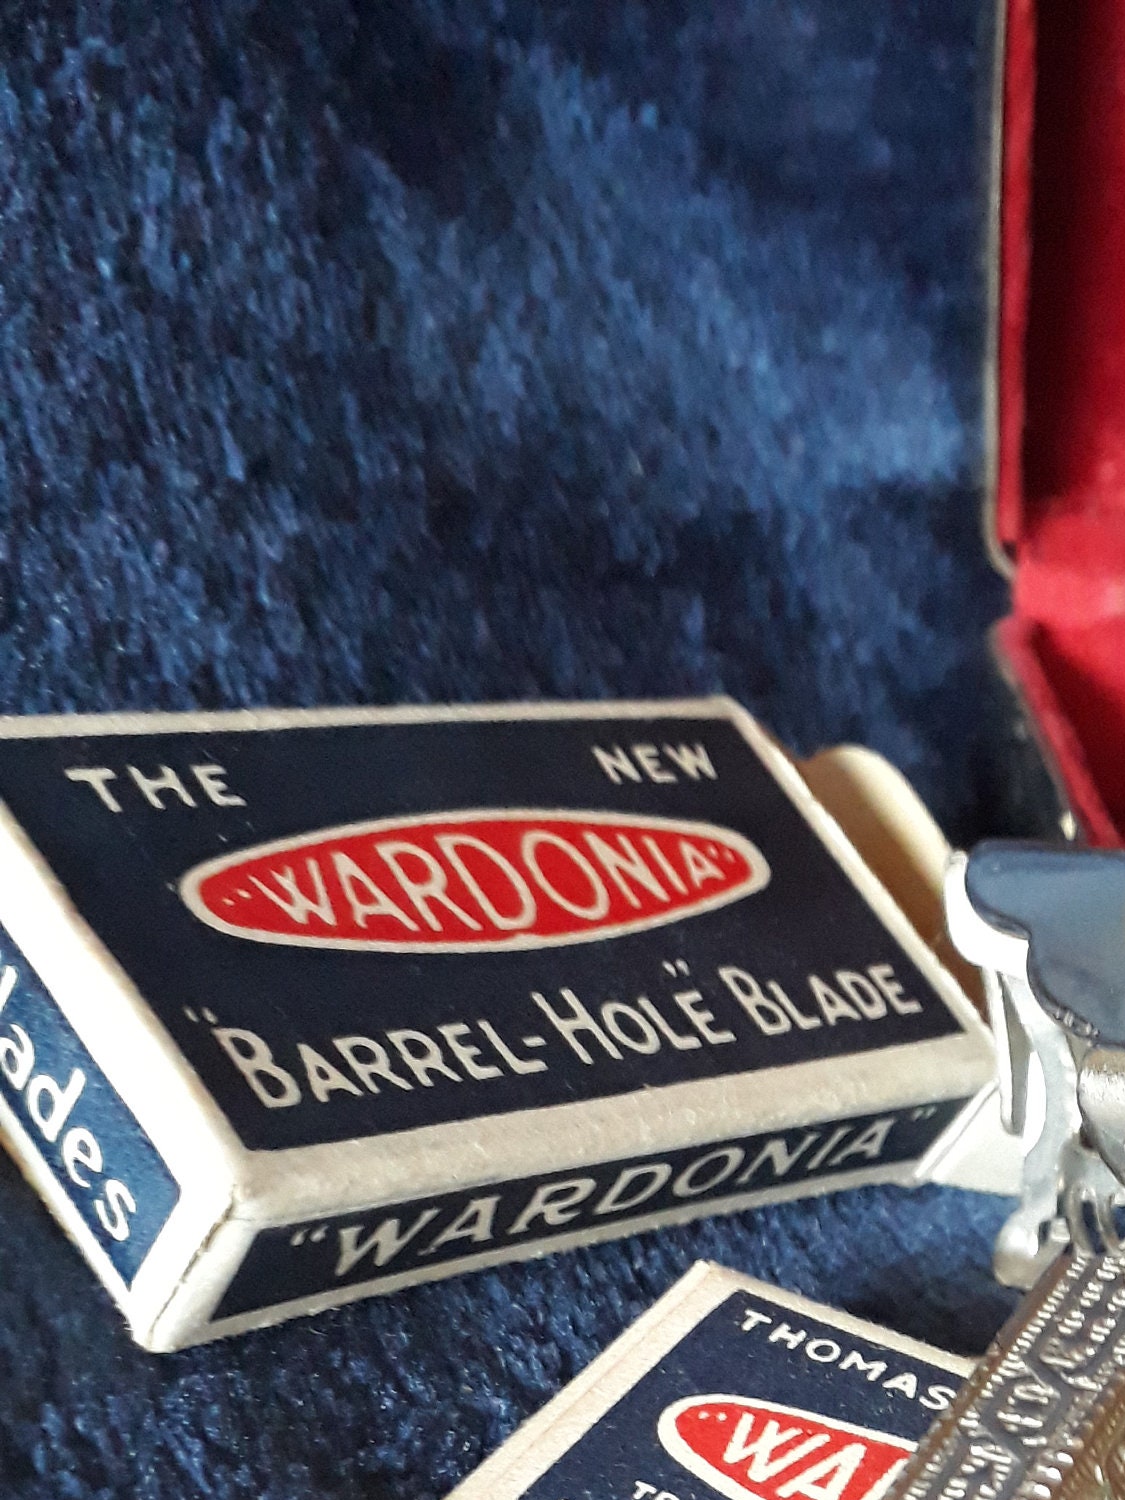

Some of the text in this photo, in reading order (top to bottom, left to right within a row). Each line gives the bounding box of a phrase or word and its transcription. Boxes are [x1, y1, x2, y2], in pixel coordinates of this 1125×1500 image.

[64, 742, 717, 813] THE NEW
[717, 963, 923, 1037] BLADE
[291, 1107, 938, 1276] "WARDONIA"
[740, 1308, 958, 1412] THOMAS
